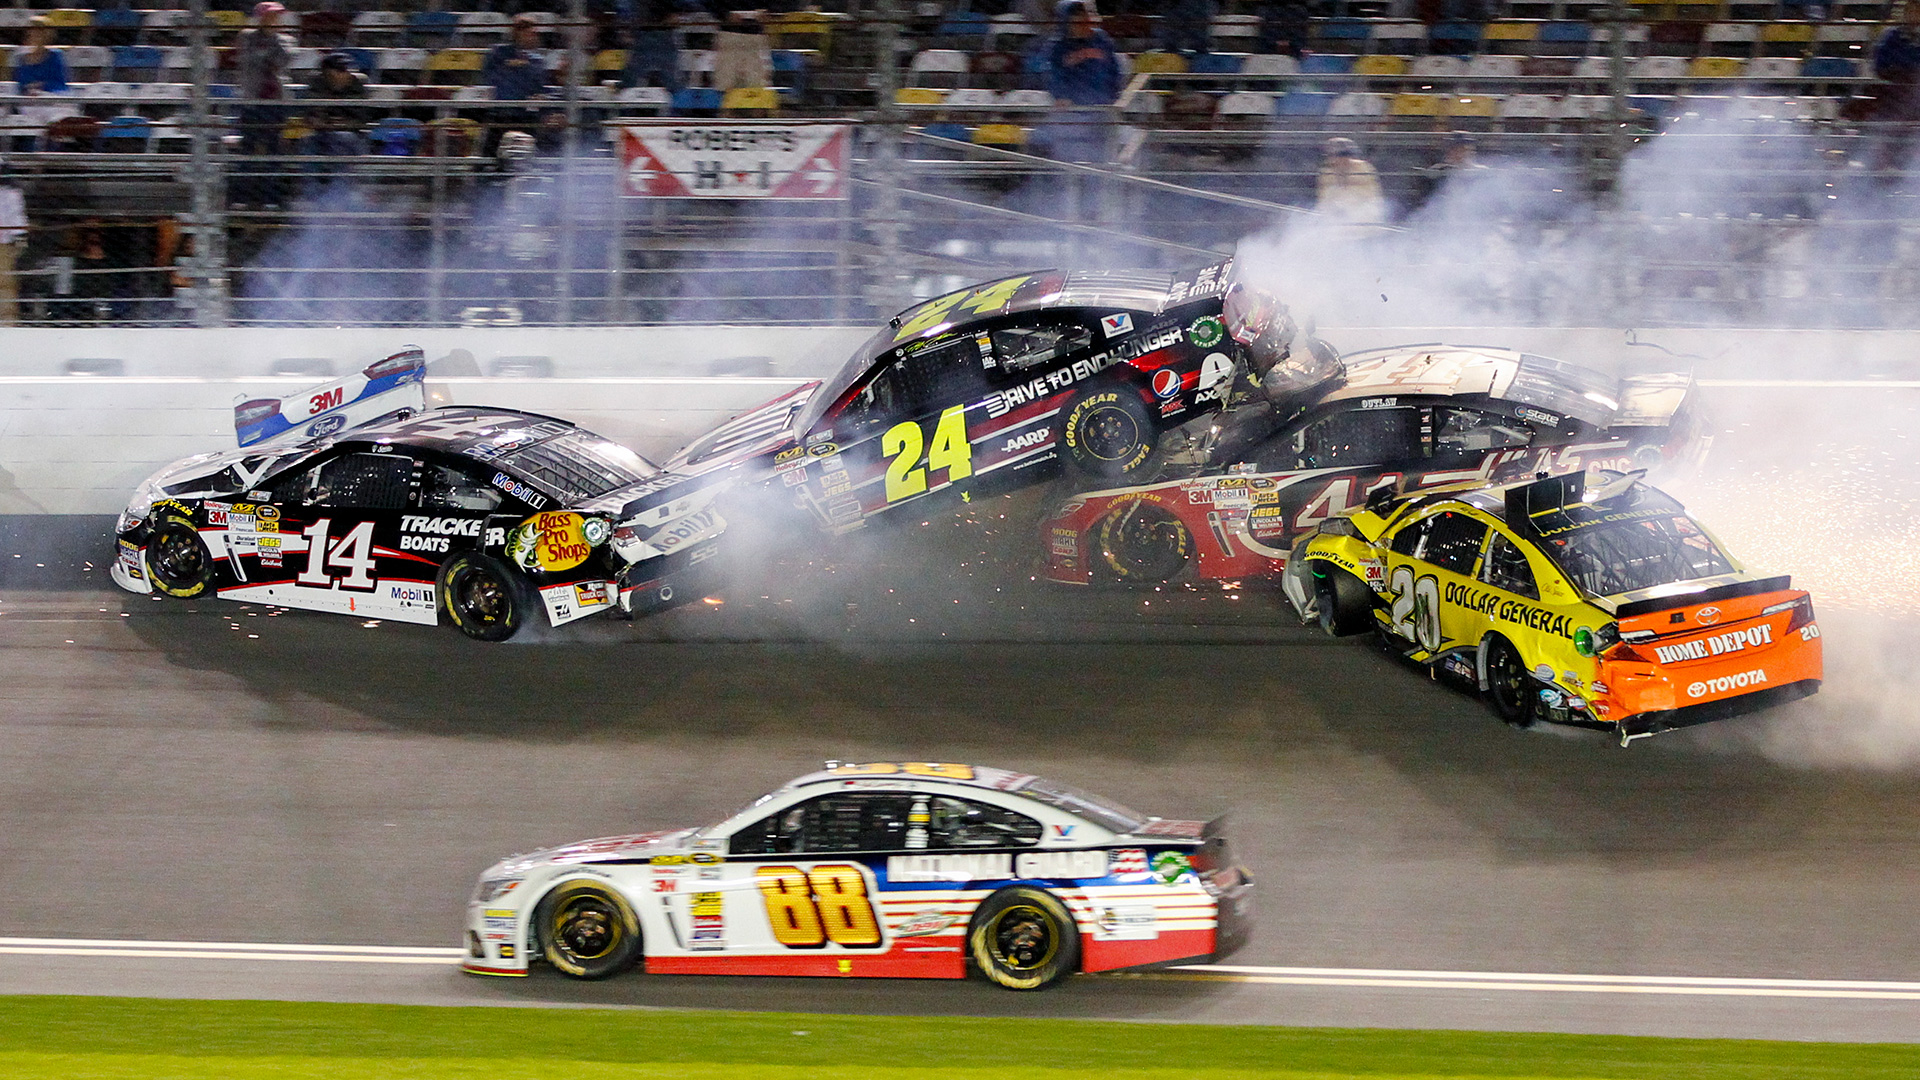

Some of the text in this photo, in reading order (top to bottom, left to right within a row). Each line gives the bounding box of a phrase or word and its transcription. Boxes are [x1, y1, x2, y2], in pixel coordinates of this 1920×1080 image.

[668, 130, 796, 152] ROBERTS
[1049, 366, 1074, 390] TO
[1074, 352, 1110, 380] END
[1109, 326, 1184, 364] HUNGER
[309, 387, 343, 414] 3M
[1361, 398, 1398, 408] OUTLAW
[1065, 393, 1118, 447] GOODYEAR
[1527, 409, 1560, 424] state
[313, 417, 339, 437] Ford
[1001, 428, 1050, 453] AARP
[882, 403, 972, 502] 24
[1122, 444, 1151, 474] EAGLE
[492, 472, 548, 510] Mobil 1
[824, 482, 852, 497] JEGS
[1189, 490, 1212, 503] 3M
[1214, 490, 1237, 498] Mobil
[1107, 491, 1162, 508] GOODYEAR
[209, 511, 227, 524] 3M
[229, 514, 247, 523] Mobil
[1251, 507, 1281, 517] JEGS
[1604, 507, 1676, 522] GENERAL
[537, 513, 571, 531] Bass
[258, 537, 281, 547] JEGS
[400, 536, 450, 553] BOATS
[543, 529, 569, 546] Pro
[297, 518, 377, 590] 14
[547, 540, 589, 562] Shops
[1304, 551, 1355, 570] GOODYEAR
[1366, 566, 1382, 579] 3M
[391, 587, 422, 600] Mobil
[1391, 564, 1442, 655] 20
[1445, 581, 1574, 640] DOLLAR GENERAL
[1800, 624, 1821, 642] 20
[1654, 623, 1772, 664] HOME DEPOT
[1706, 669, 1768, 693] TOYOTA
[653, 879, 677, 893] 3M
[754, 865, 884, 950] 88
